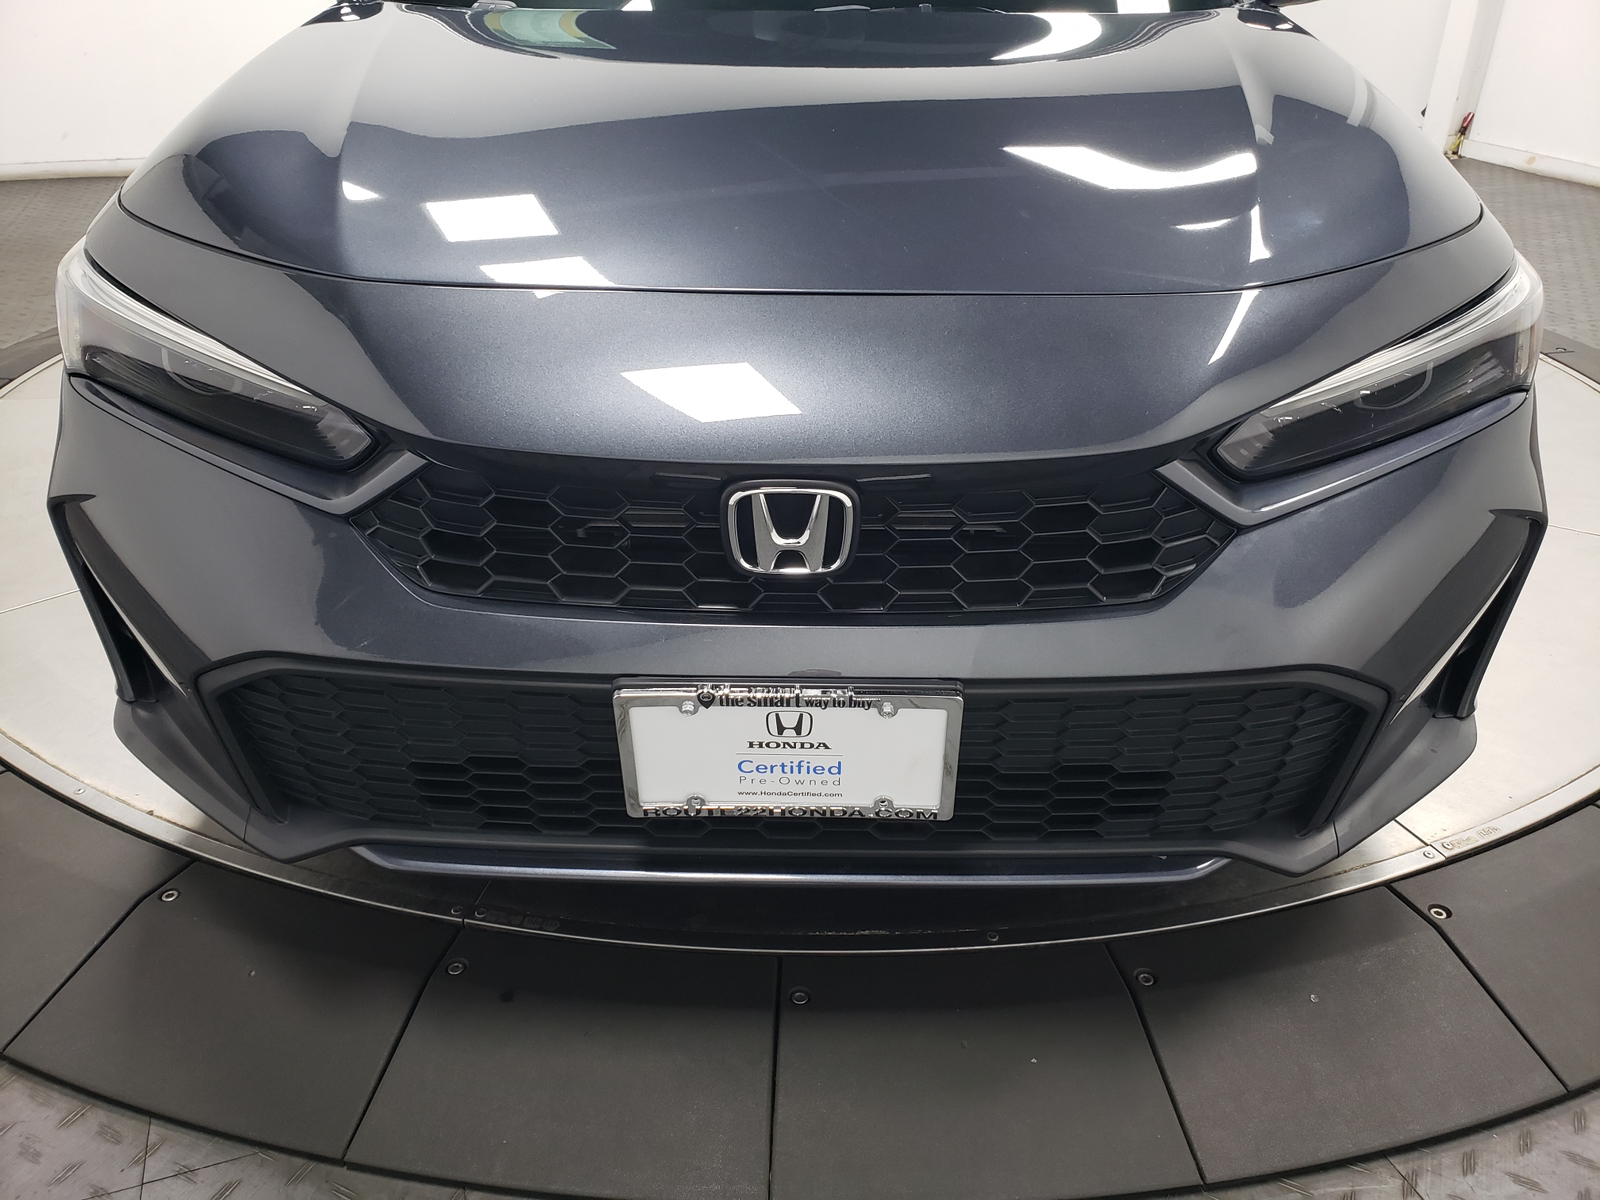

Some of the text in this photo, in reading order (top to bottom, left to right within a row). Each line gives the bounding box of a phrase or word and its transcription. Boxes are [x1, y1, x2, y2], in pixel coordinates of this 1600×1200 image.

[719, 690, 873, 710] the smart way to buy
[747, 741, 832, 750] HONDA
[737, 760, 842, 775] Certified
[739, 775, 841, 787] Pre-Owned
[737, 790, 843, 798] www.HondaCertified.com
[643, 806, 938, 820] ROUTE22HONDA.COM
